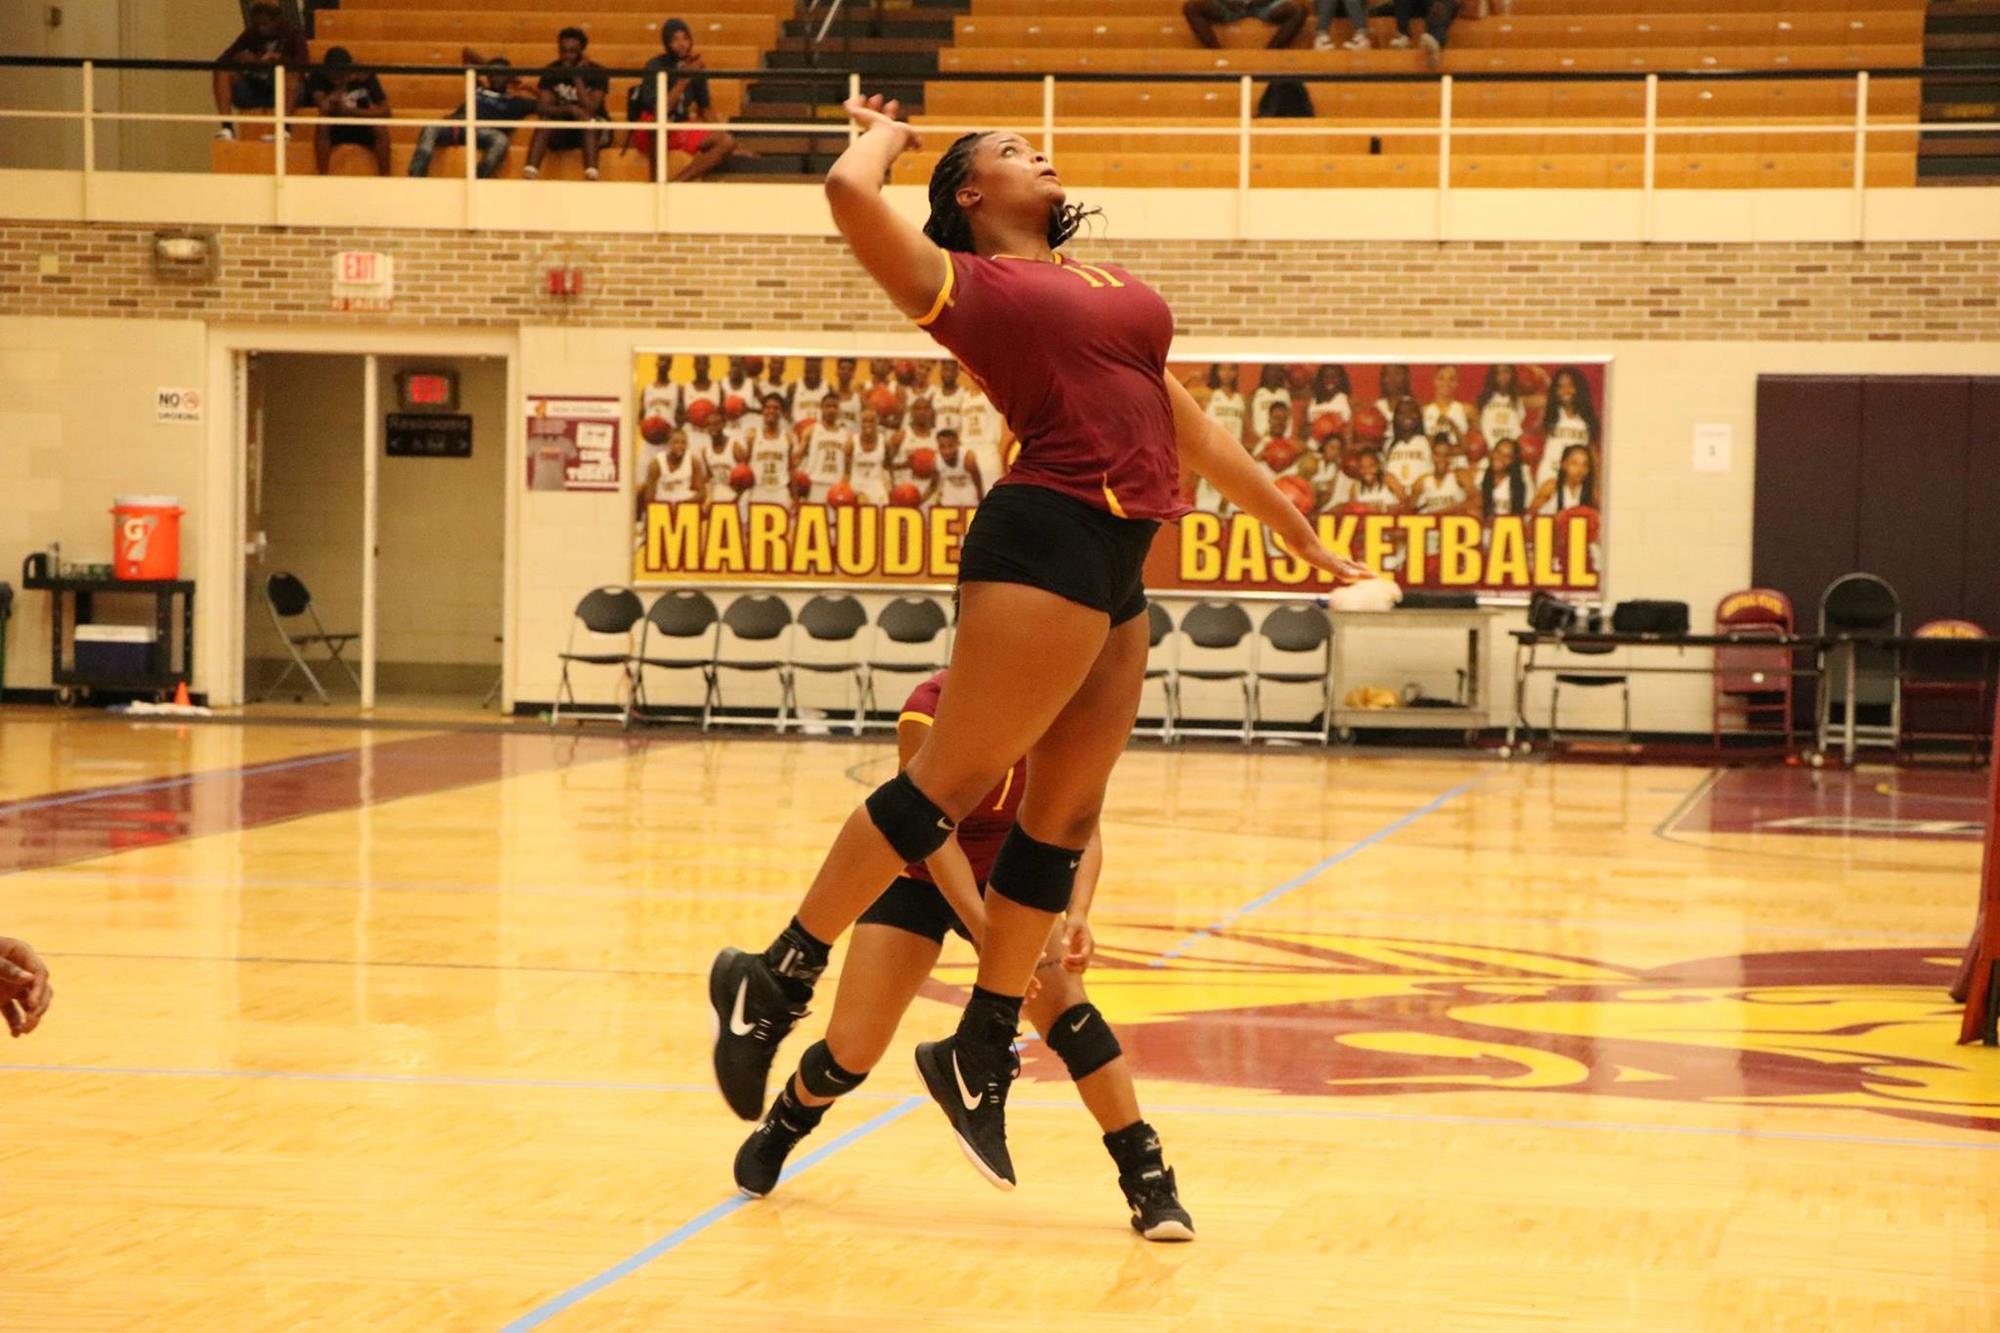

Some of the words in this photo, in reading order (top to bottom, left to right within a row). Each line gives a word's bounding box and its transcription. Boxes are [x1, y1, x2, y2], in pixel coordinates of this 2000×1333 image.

[344, 252, 376, 281] EXIT
[1062, 264, 1125, 288] 11
[159, 392, 180, 408] NO
[124, 517, 144, 541] G
[646, 503, 977, 576] MARAUDE
